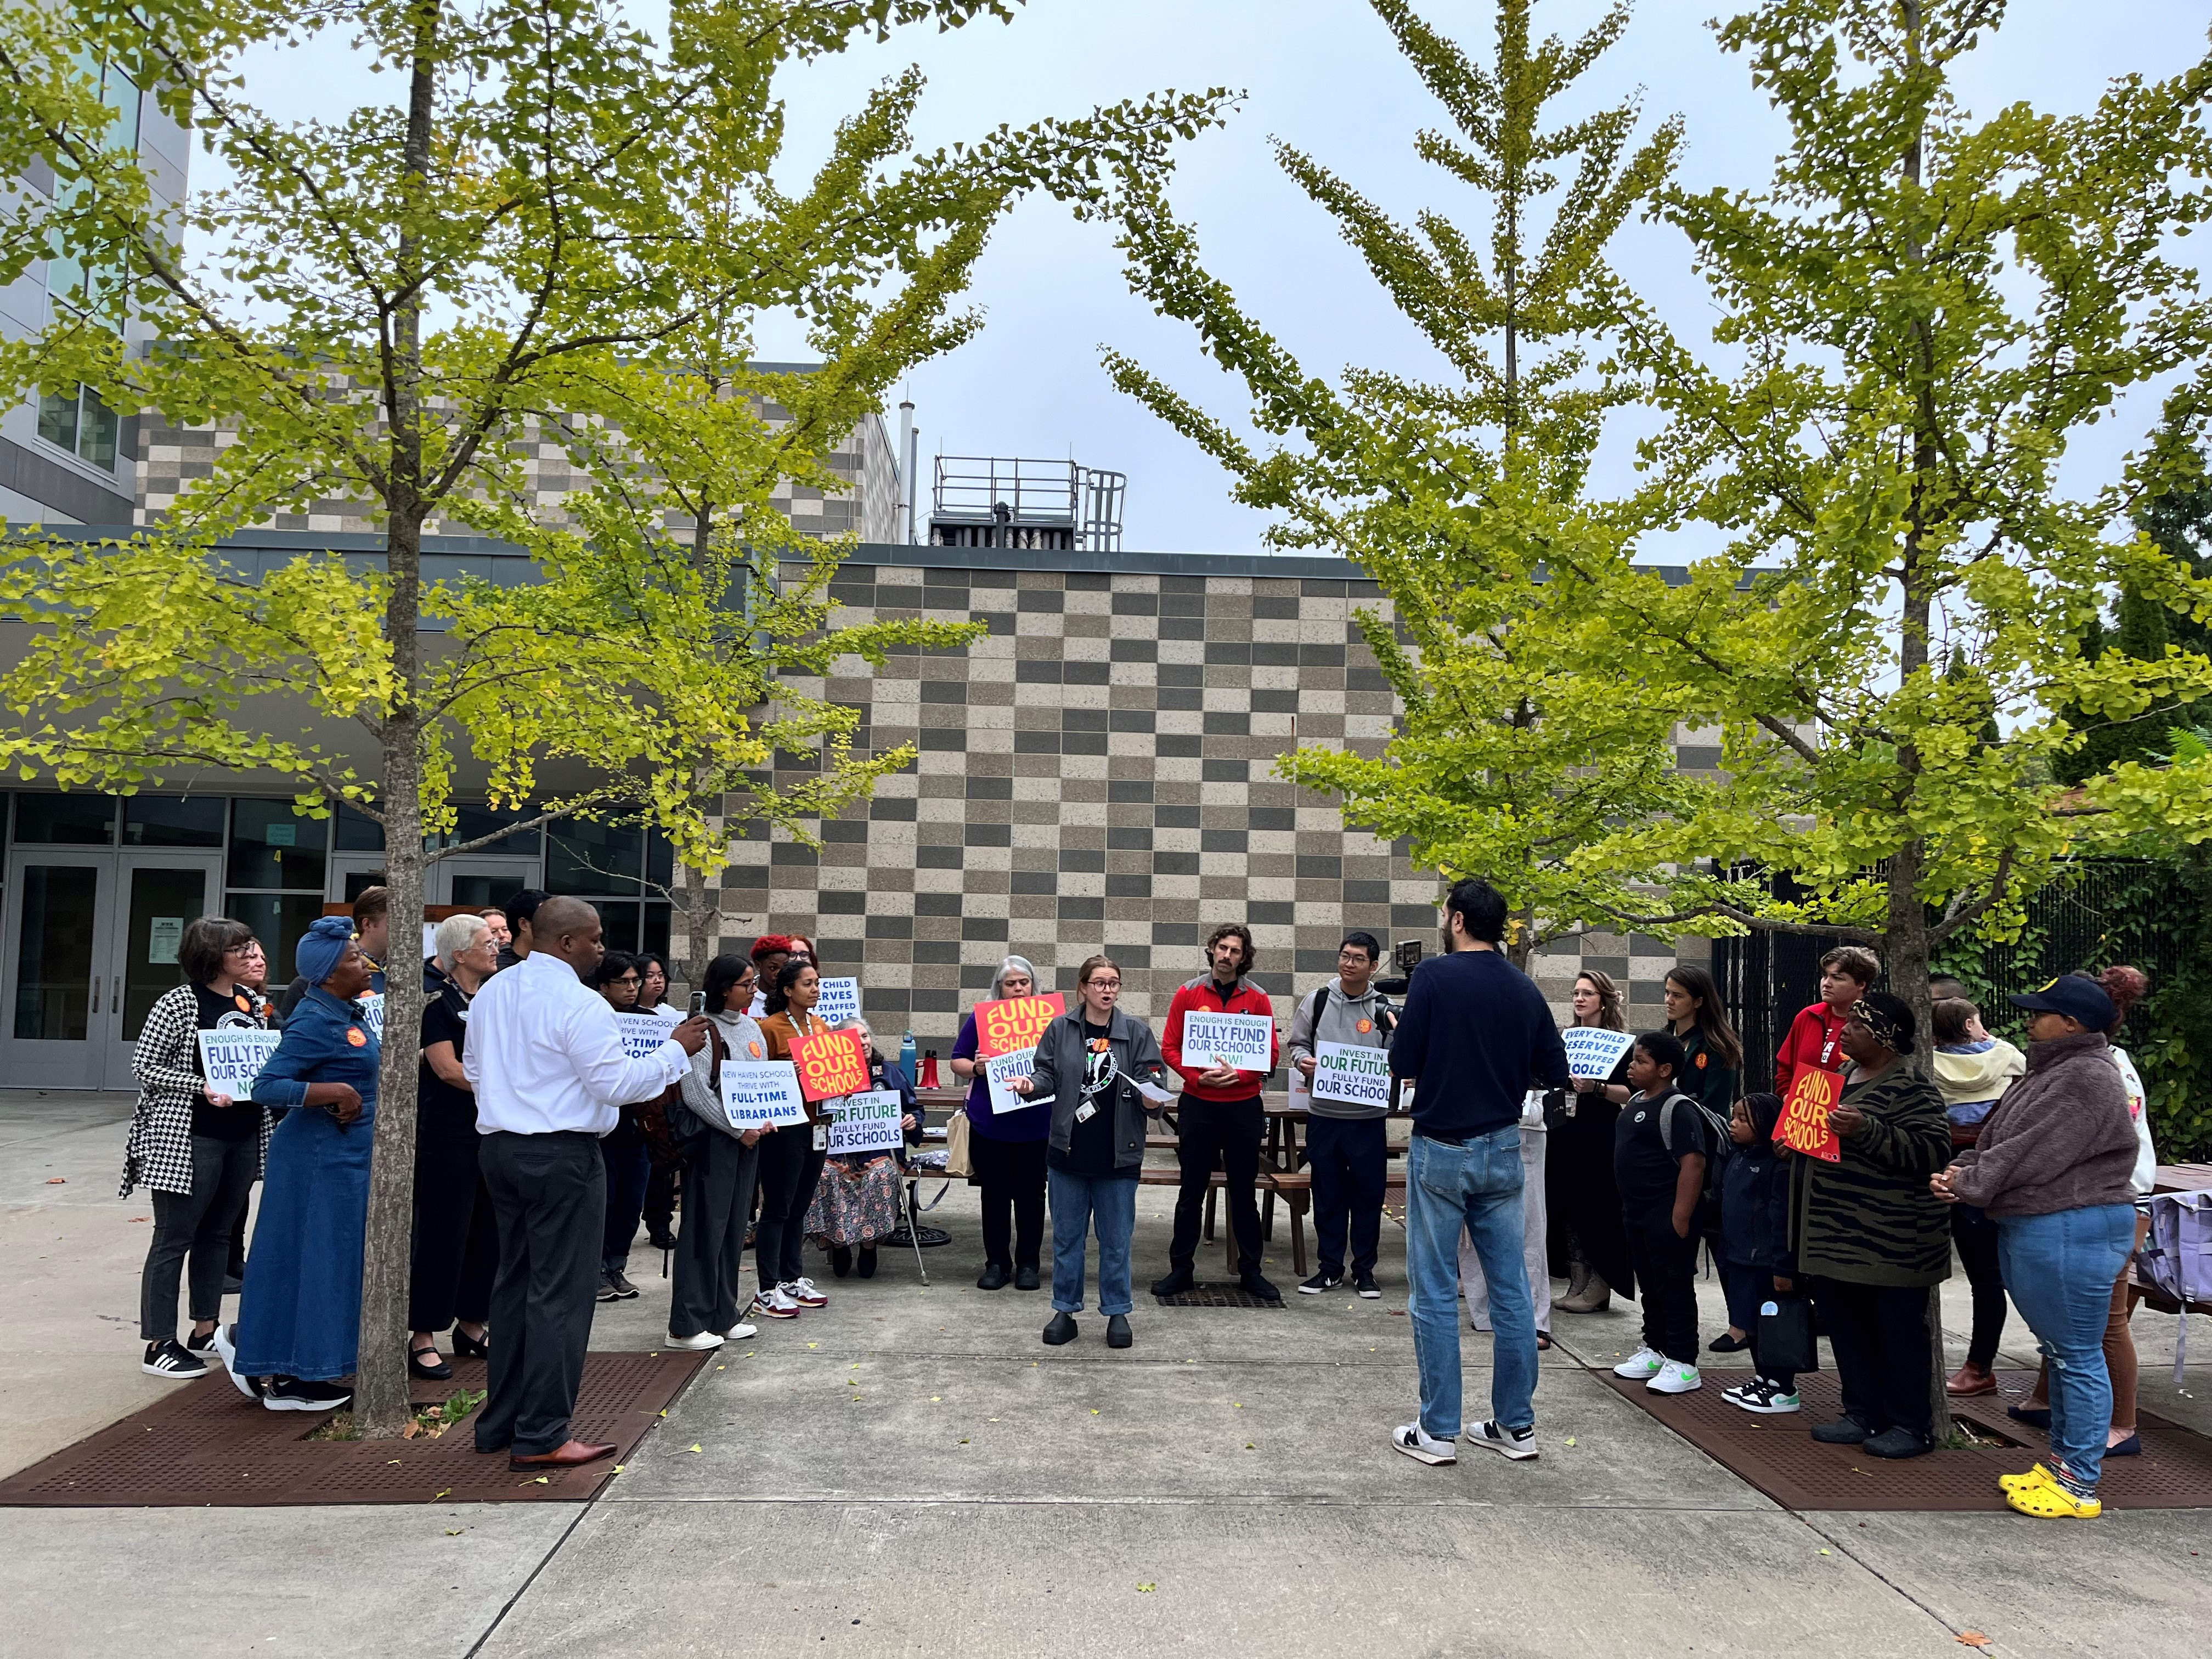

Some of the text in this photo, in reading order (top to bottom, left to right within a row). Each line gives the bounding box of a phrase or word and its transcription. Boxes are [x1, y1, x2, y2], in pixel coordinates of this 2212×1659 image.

[819, 1003, 856, 1011] STAFFED
[987, 998, 1054, 1024] FUND
[641, 1019, 678, 1028] SCHOOLS
[988, 1017, 1054, 1038] OUR
[1189, 1015, 1222, 1024] ENOUGH
[1234, 1018, 1268, 1027] ENOUGH
[205, 1035, 243, 1044] ENOUGH
[1189, 1024, 1266, 1042] FULLY FUND
[1565, 1030, 1626, 1043] EVERY CHILD
[802, 1034, 855, 1062] FUND
[1188, 1039, 1265, 1054] OUR SCHOOLS
[1340, 1048, 1372, 1059] INVEST
[1565, 1040, 1621, 1054] ESERVES
[207, 1045, 250, 1064] FULLY
[1016, 1051, 1034, 1060] OUR
[1573, 1053, 1615, 1064] STAFFED
[806, 1054, 860, 1077] OUR
[990, 1056, 1014, 1068] FUND
[1321, 1055, 1390, 1076] OUR FUTUR
[1569, 1063, 1605, 1075] OOLS
[211, 1064, 237, 1080] OUR
[760, 1070, 793, 1079] SCHOOLS
[993, 1059, 1034, 1084] SCHOO
[810, 1069, 864, 1094] SCHOOLS
[1332, 1073, 1385, 1086] FULLY FUND
[1317, 1079, 1390, 1101] OUR SCHOOL
[1796, 1070, 1831, 1105] FUND
[732, 1091, 787, 1103] FULL-TIME
[842, 1097, 868, 1107] NVEST
[731, 1106, 797, 1119] LIBRARIANS
[850, 1104, 897, 1121] FUTURE
[1790, 1097, 1828, 1128] OUR
[834, 1122, 886, 1133] FULLY FUND
[1784, 1117, 1829, 1150] SCHOOLS
[828, 1129, 900, 1147] UR SCHOOLS
